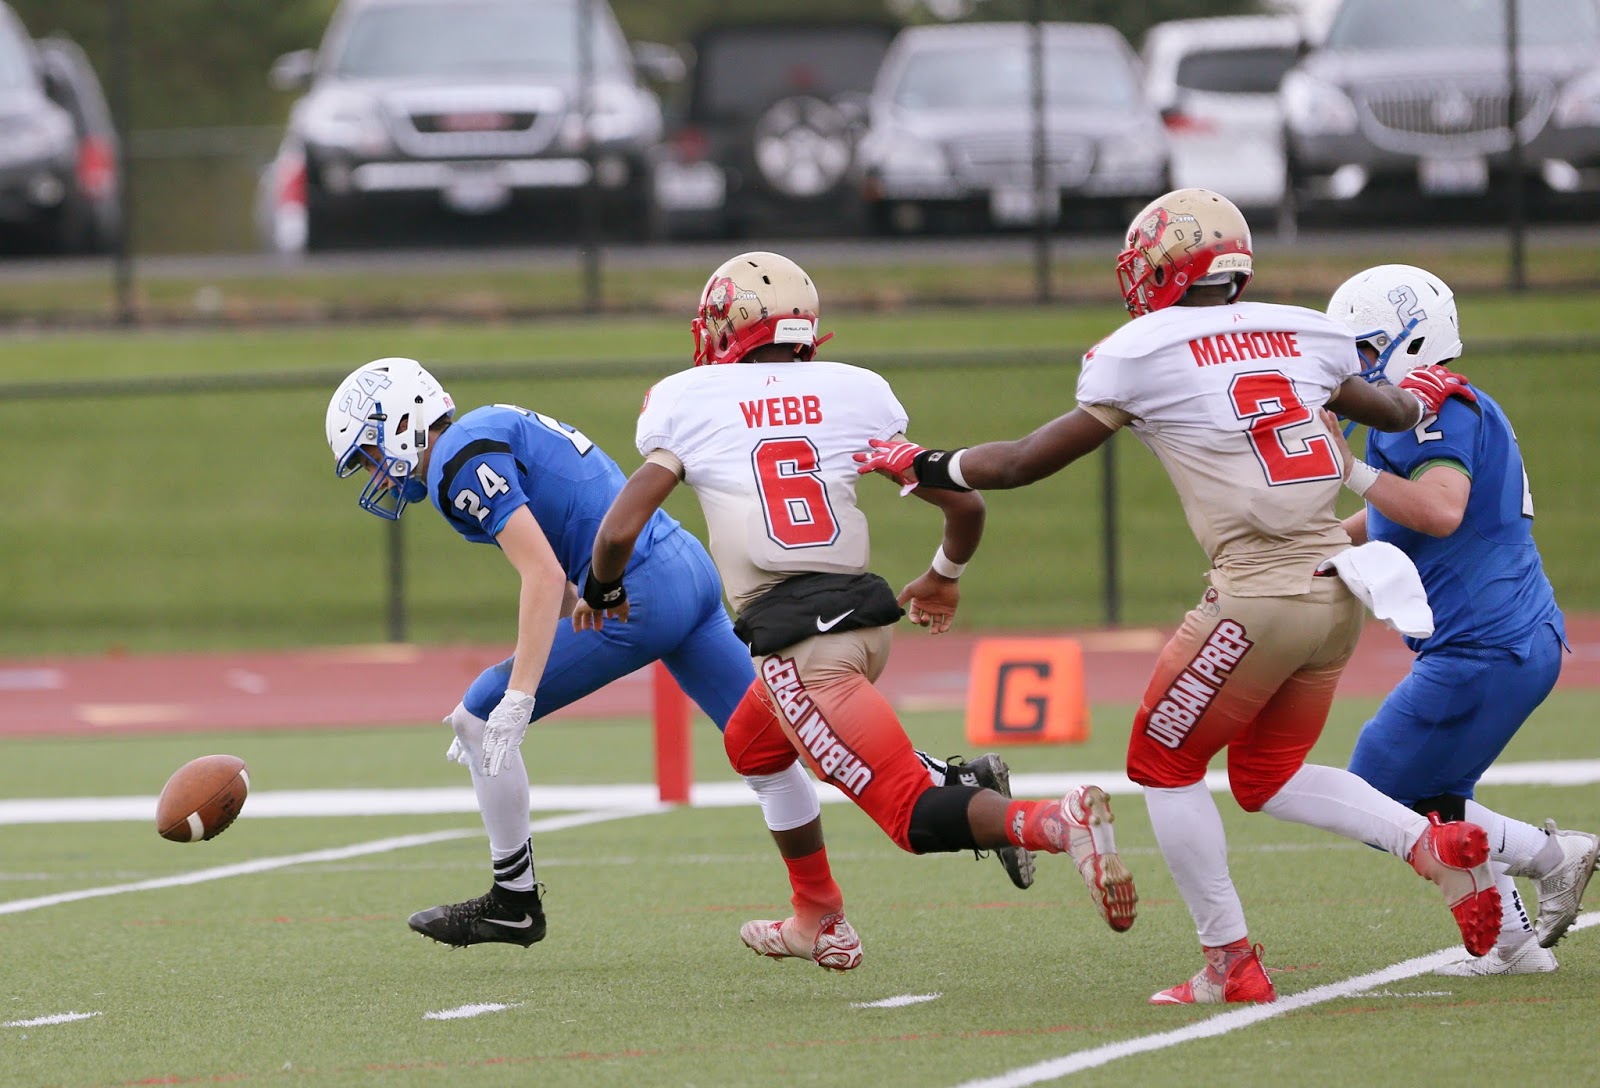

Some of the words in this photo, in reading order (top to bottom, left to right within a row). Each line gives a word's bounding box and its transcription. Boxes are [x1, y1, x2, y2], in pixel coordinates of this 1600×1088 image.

[1387, 284, 1428, 328] 2
[1188, 331, 1302, 368] MAHONE
[338, 370, 393, 423] 24
[738, 395, 823, 428] WEBB
[1227, 369, 1342, 487] 2
[454, 461, 510, 523] 24
[750, 436, 841, 550] 6
[762, 655, 814, 727] PREP
[994, 661, 1051, 733] G
[1144, 669, 1219, 749] URBAN
[1189, 619, 1254, 687] PREP
[797, 708, 874, 797] URBAN
